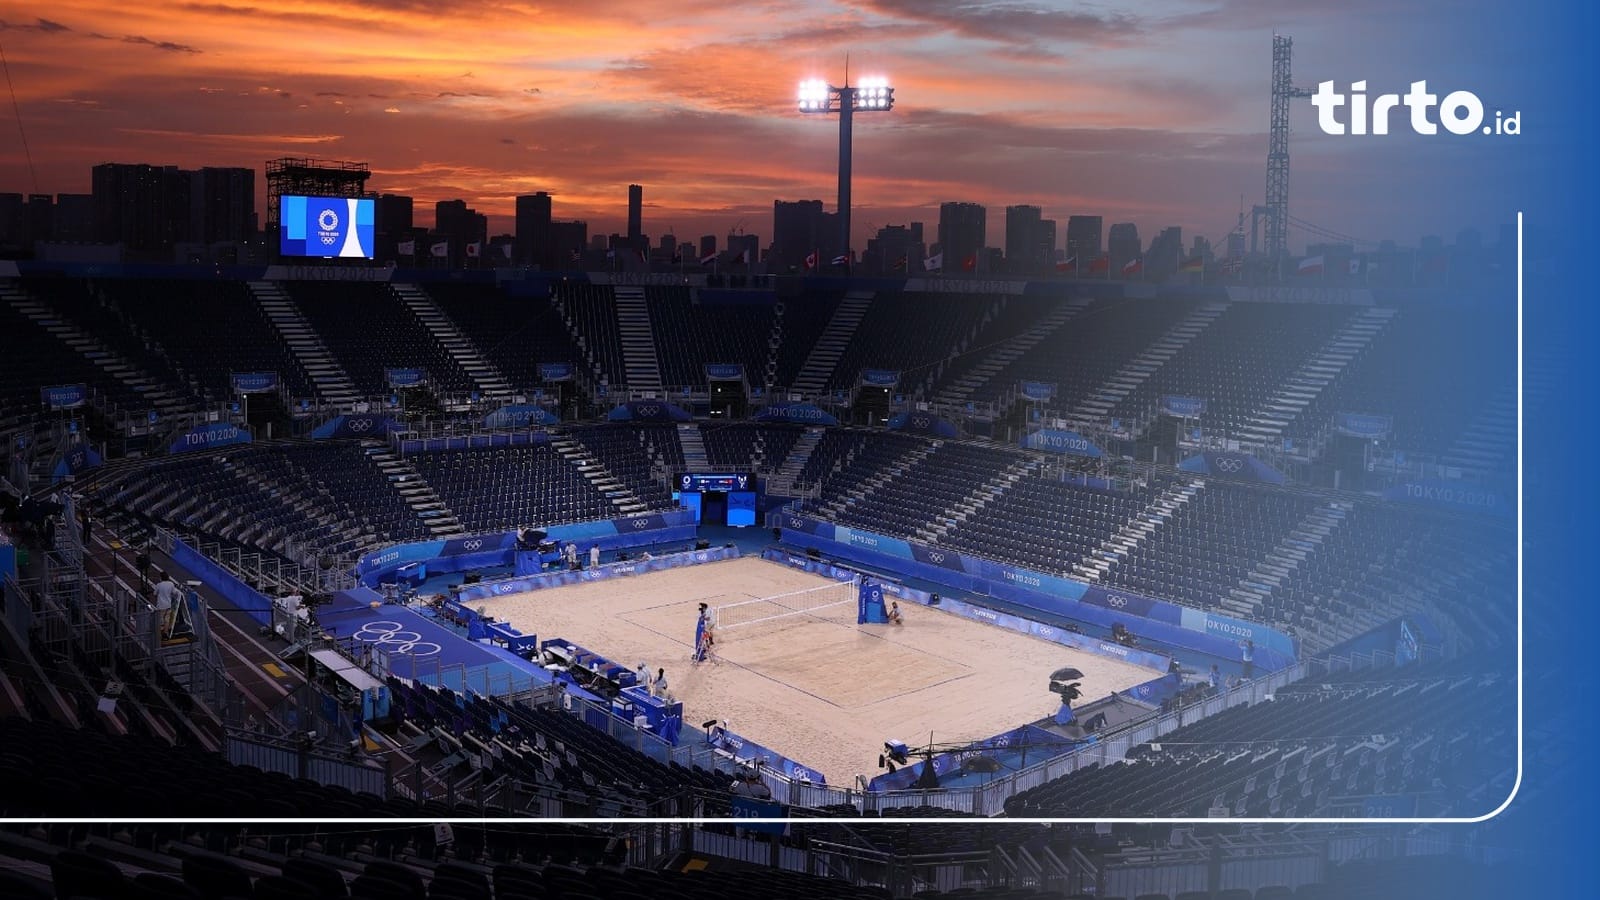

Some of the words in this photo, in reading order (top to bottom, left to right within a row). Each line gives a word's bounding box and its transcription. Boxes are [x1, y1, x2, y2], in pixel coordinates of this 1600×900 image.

[768, 407, 798, 417] TOKYO
[799, 408, 822, 419] 2020
[185, 431, 216, 445] TOKYO
[217, 427, 238, 440] 2020
[1034, 434, 1063, 447] TOKYO
[1064, 437, 1087, 450] 2020
[1405, 483, 1452, 503] TOKYO
[1456, 490, 1496, 506] 2020
[1003, 571, 1024, 583] TOKYO
[1024, 575, 1040, 587] 2020
[1204, 619, 1230, 632] TOKYO
[1230, 625, 1252, 638] 2020
